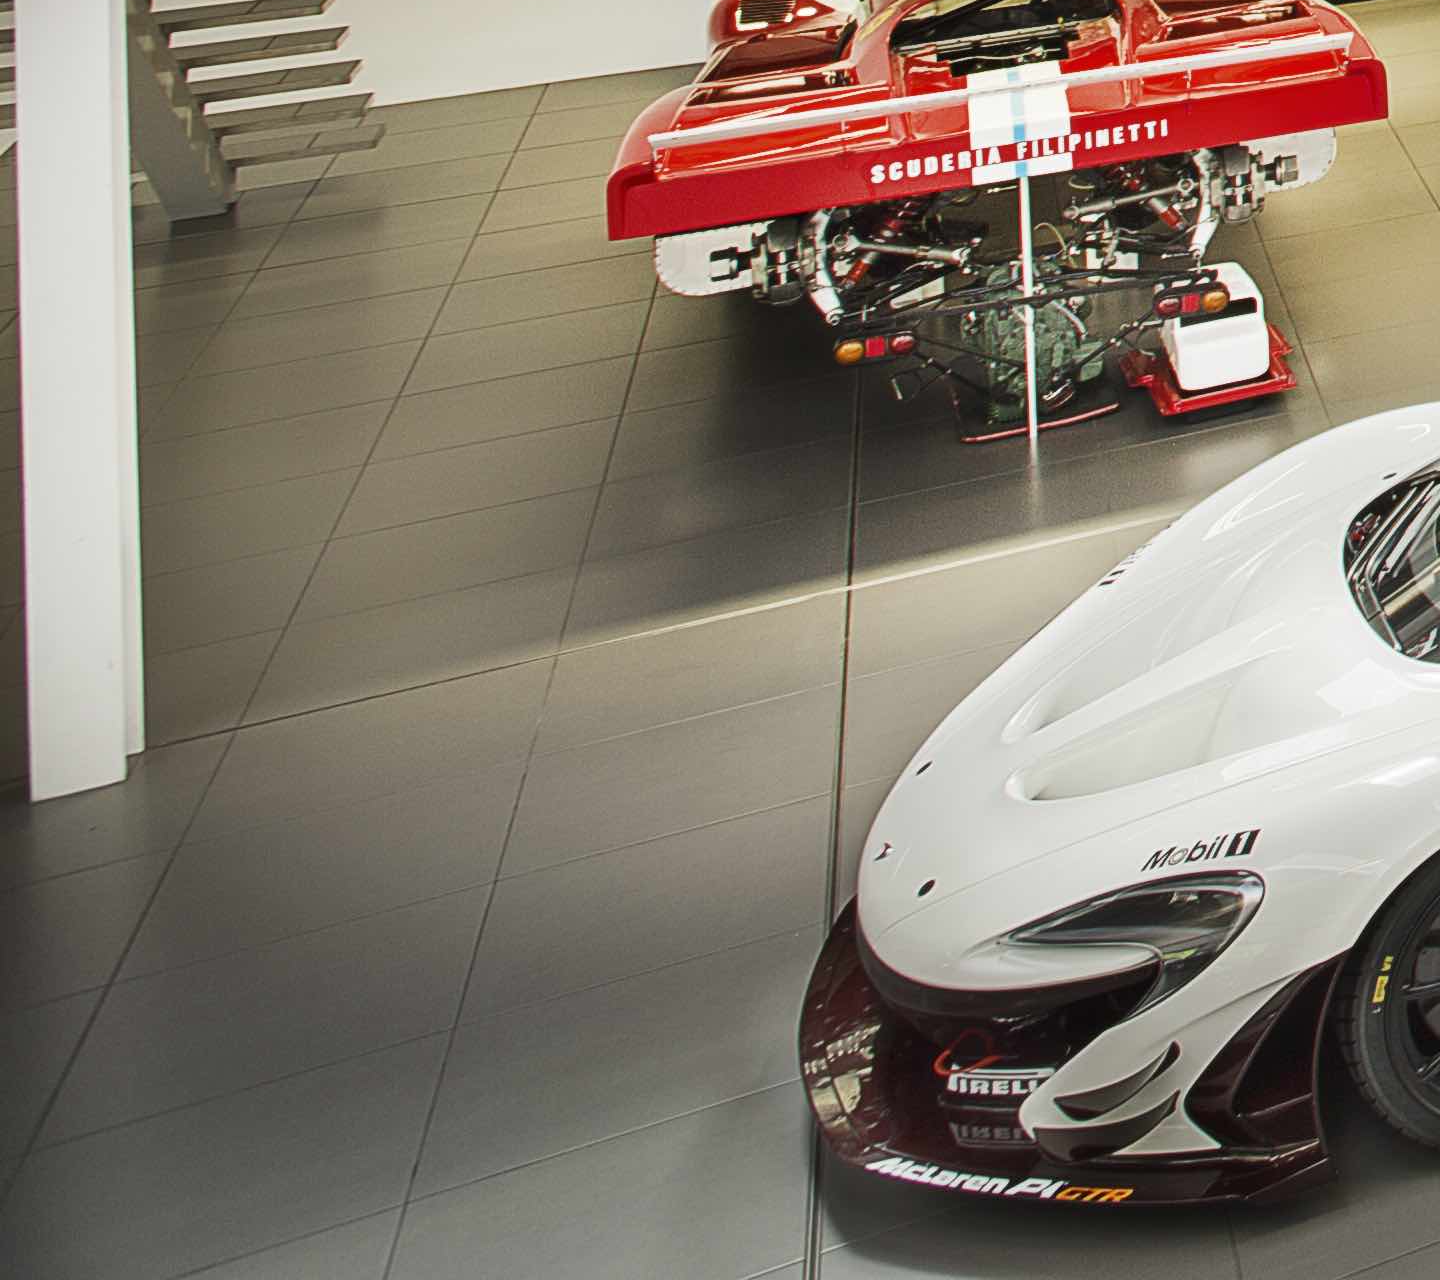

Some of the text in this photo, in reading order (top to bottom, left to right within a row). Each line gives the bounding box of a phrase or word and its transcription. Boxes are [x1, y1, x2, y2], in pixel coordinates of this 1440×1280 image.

[870, 118, 1169, 185] SCUDERIA FILIPINETTI
[1141, 834, 1230, 872] Mobil
[865, 1157, 1011, 1195] McLaren
[1055, 1186, 1134, 1202] GTR
